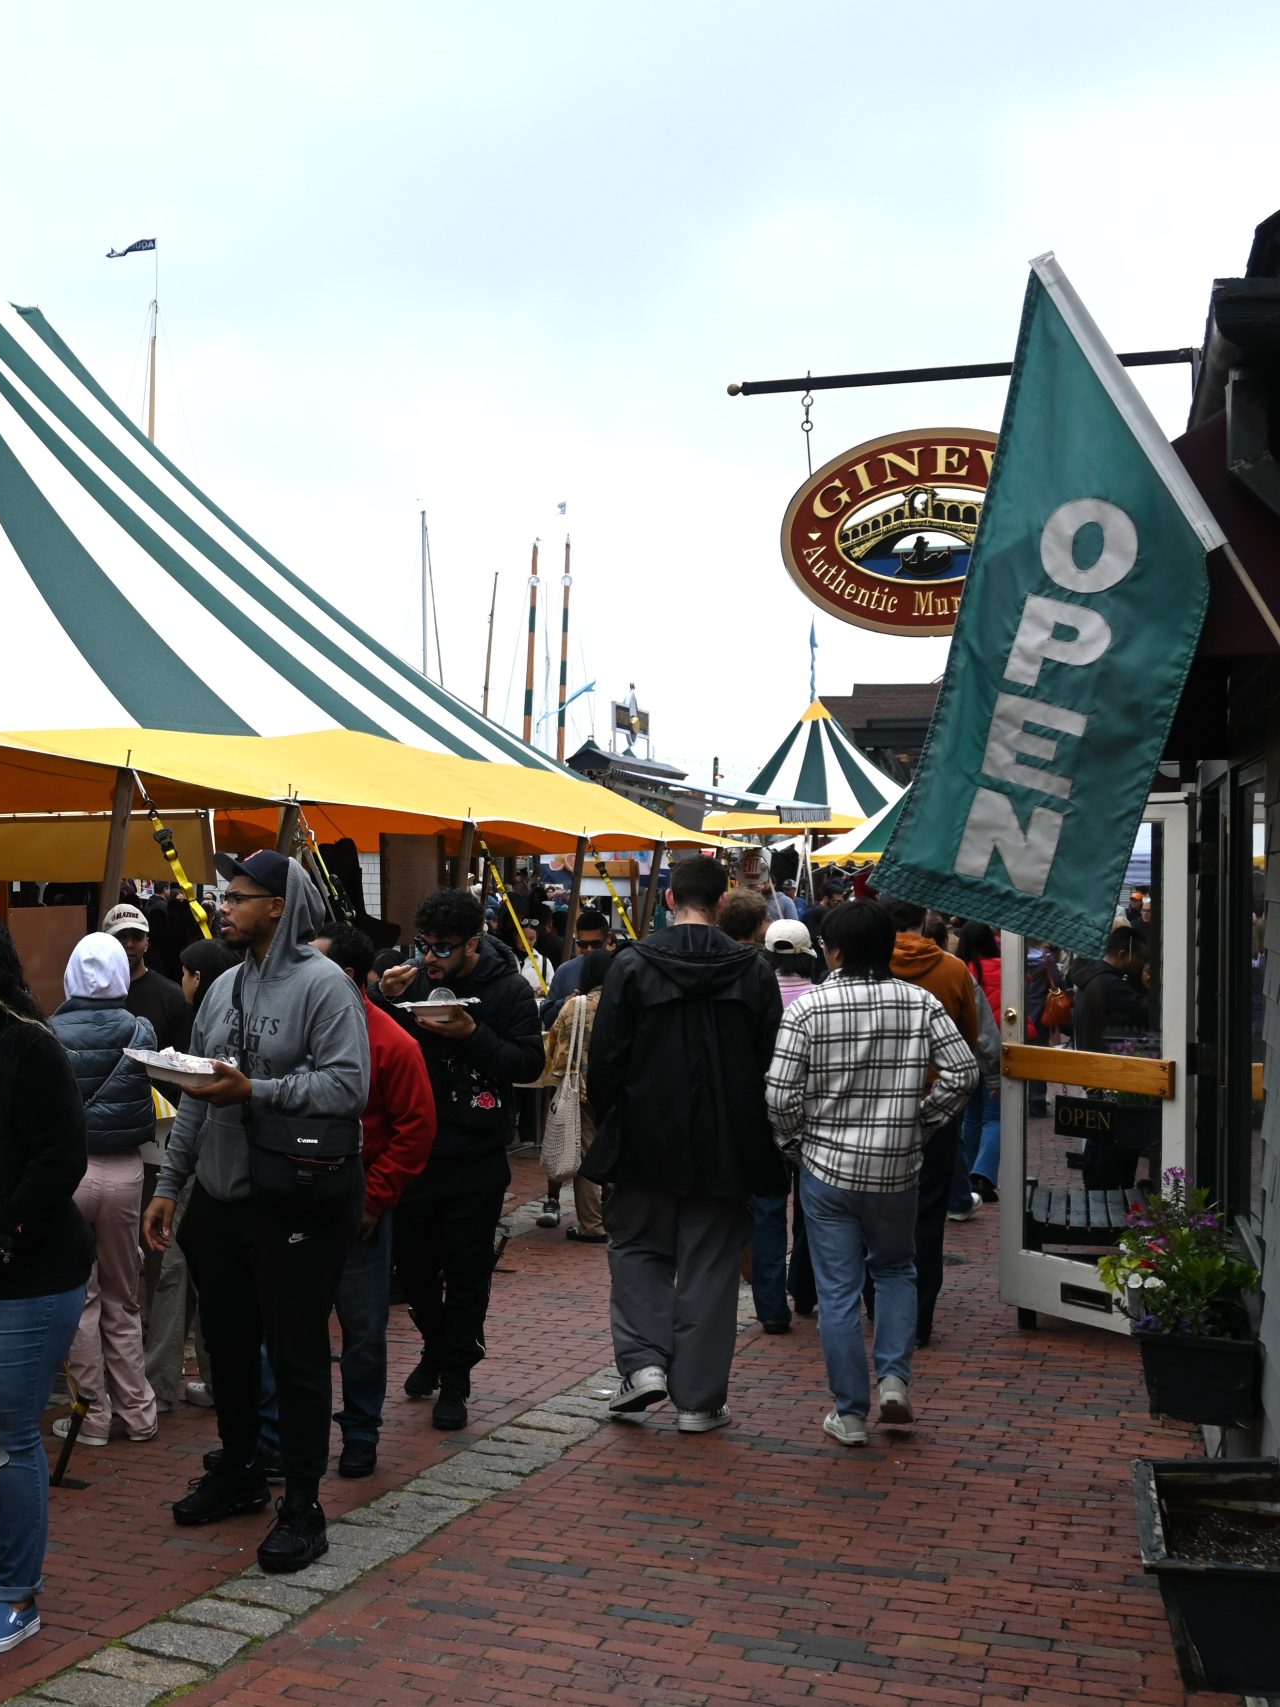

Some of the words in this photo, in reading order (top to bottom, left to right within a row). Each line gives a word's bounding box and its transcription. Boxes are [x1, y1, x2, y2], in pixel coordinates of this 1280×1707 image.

[803, 546, 898, 614] Authentic
[955, 498, 1139, 897] OPEN
[223, 1008, 280, 1035] REULTS
[1058, 1106, 1112, 1131] OPEN
